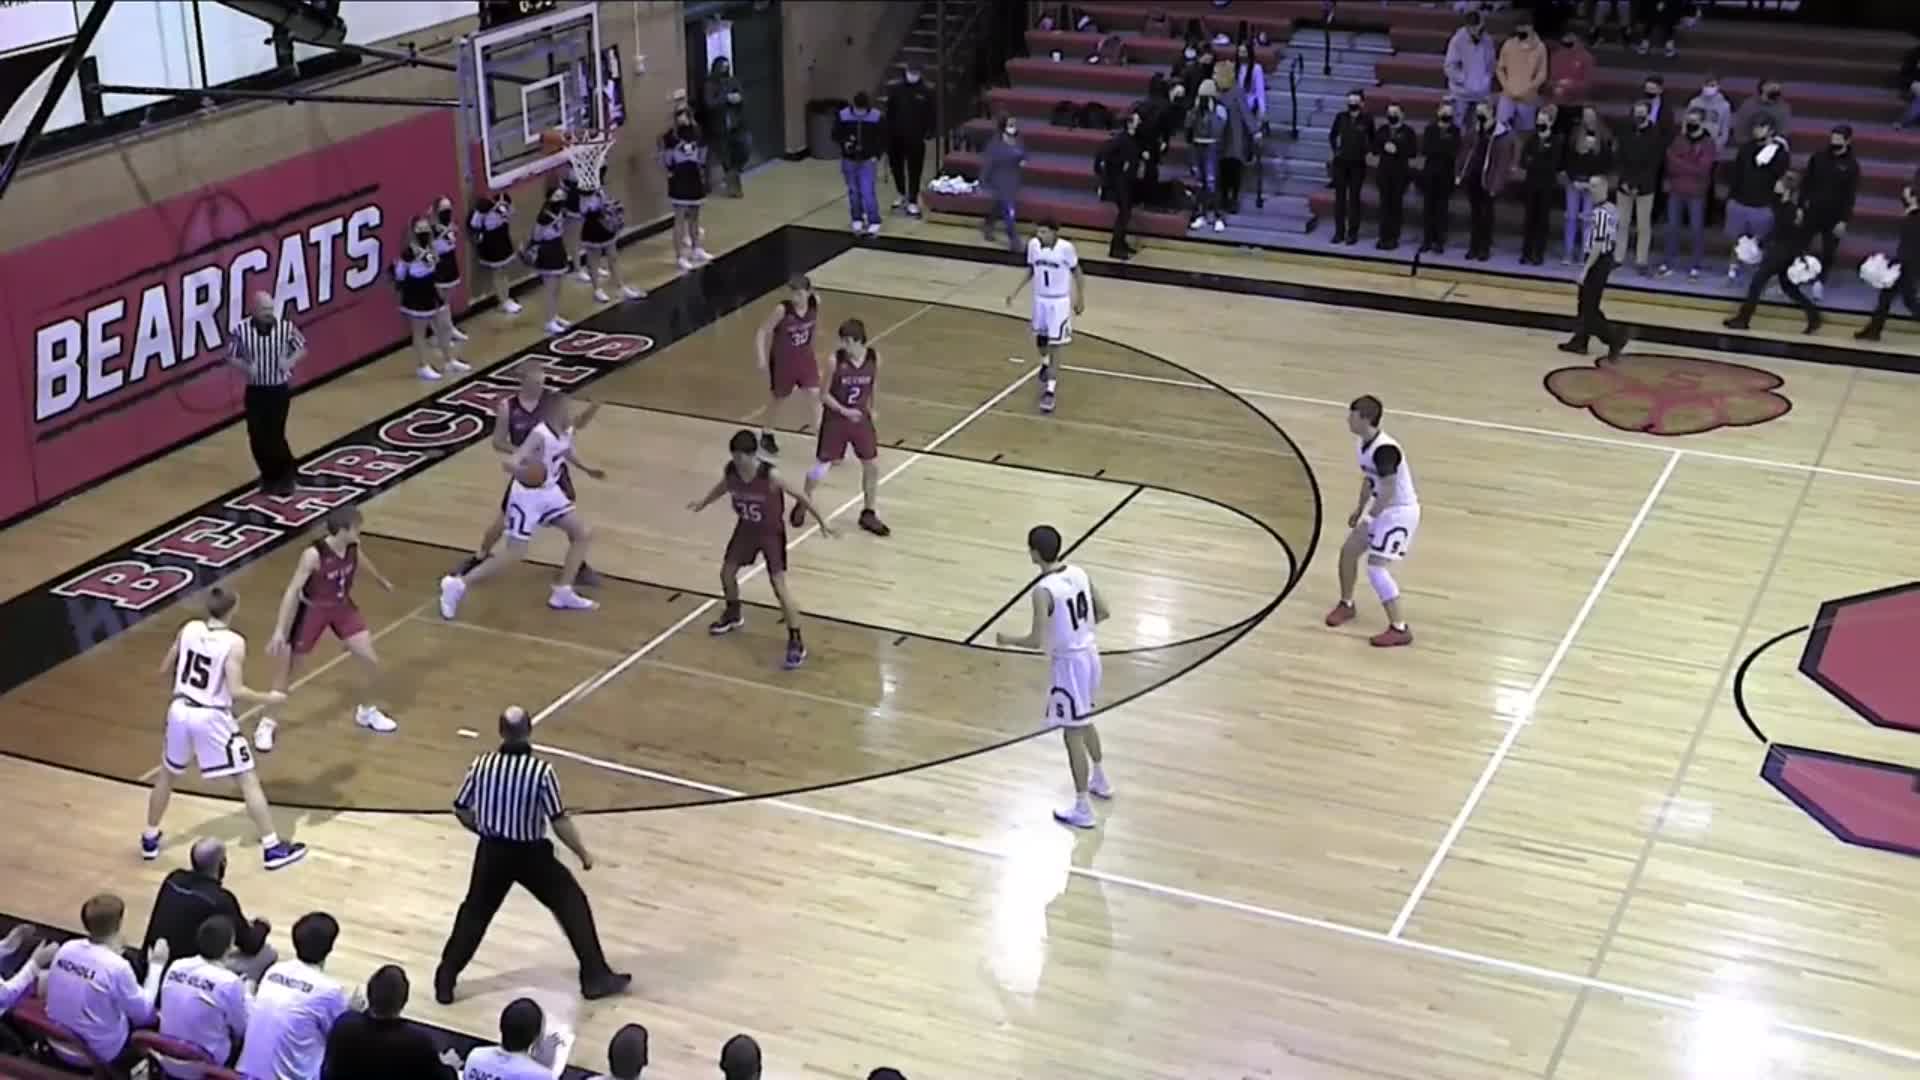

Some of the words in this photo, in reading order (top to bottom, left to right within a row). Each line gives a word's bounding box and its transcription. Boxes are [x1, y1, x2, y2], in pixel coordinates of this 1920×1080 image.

[1043, 268, 1050, 288] 1
[35, 205, 383, 422] BEARCATS
[847, 386, 861, 405] 2
[1066, 590, 1089, 632] 14
[180, 648, 212, 691] 15
[239, 745, 251, 763] S
